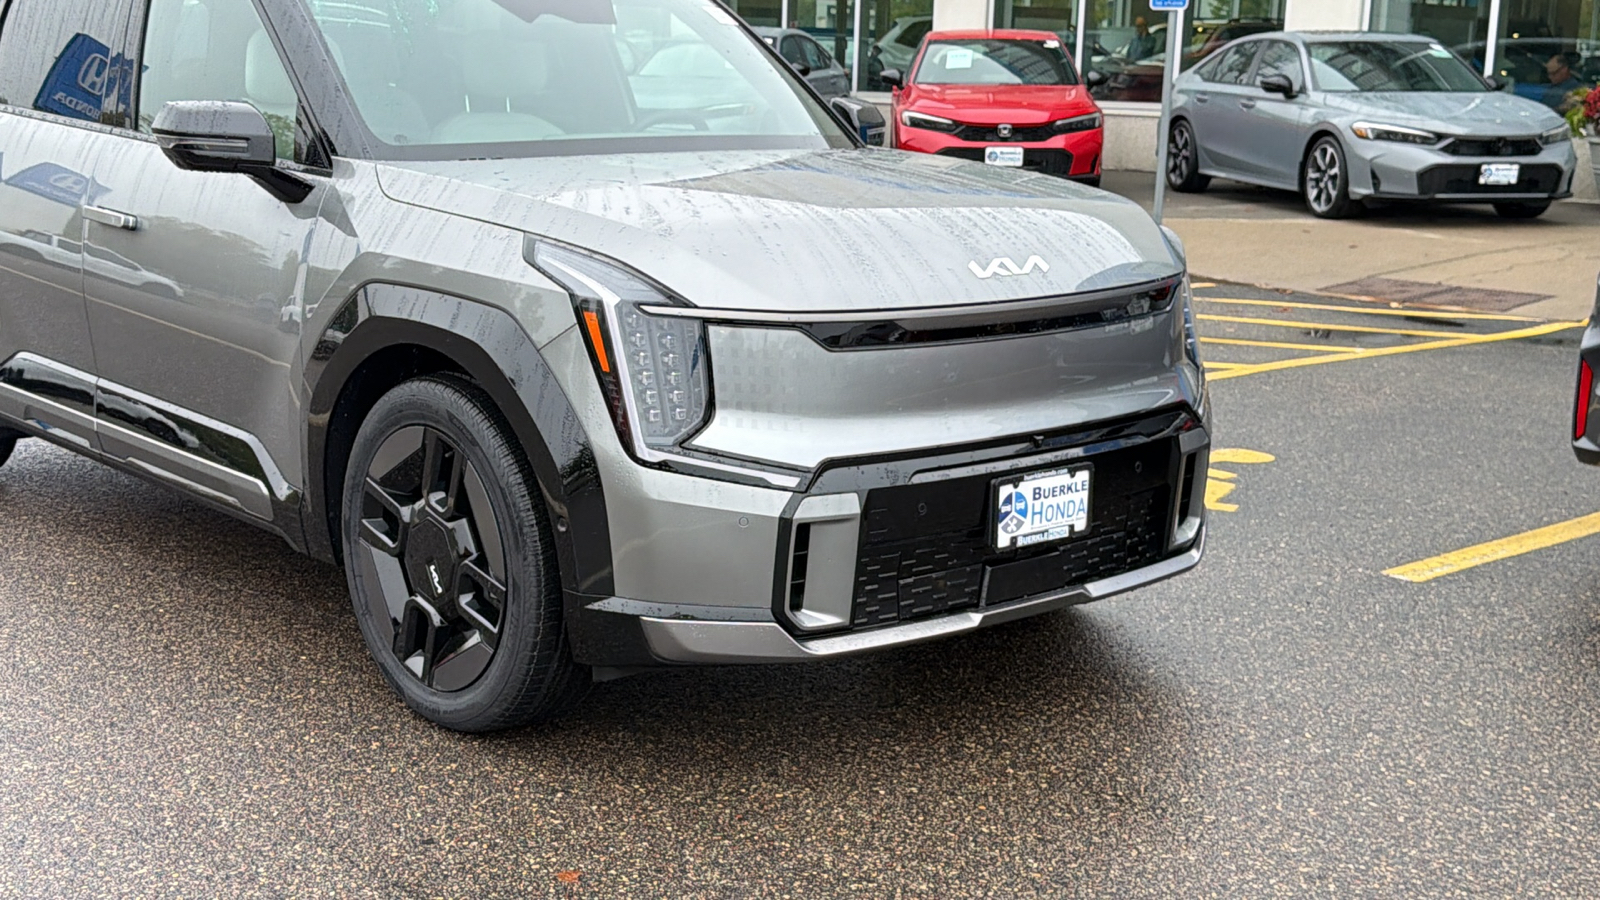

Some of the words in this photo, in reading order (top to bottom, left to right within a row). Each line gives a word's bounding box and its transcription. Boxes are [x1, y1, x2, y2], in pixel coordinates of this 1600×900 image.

[967, 254, 1050, 279] KIA
[1032, 480, 1088, 501] BUERKLE
[1031, 498, 1086, 526] HONDA
